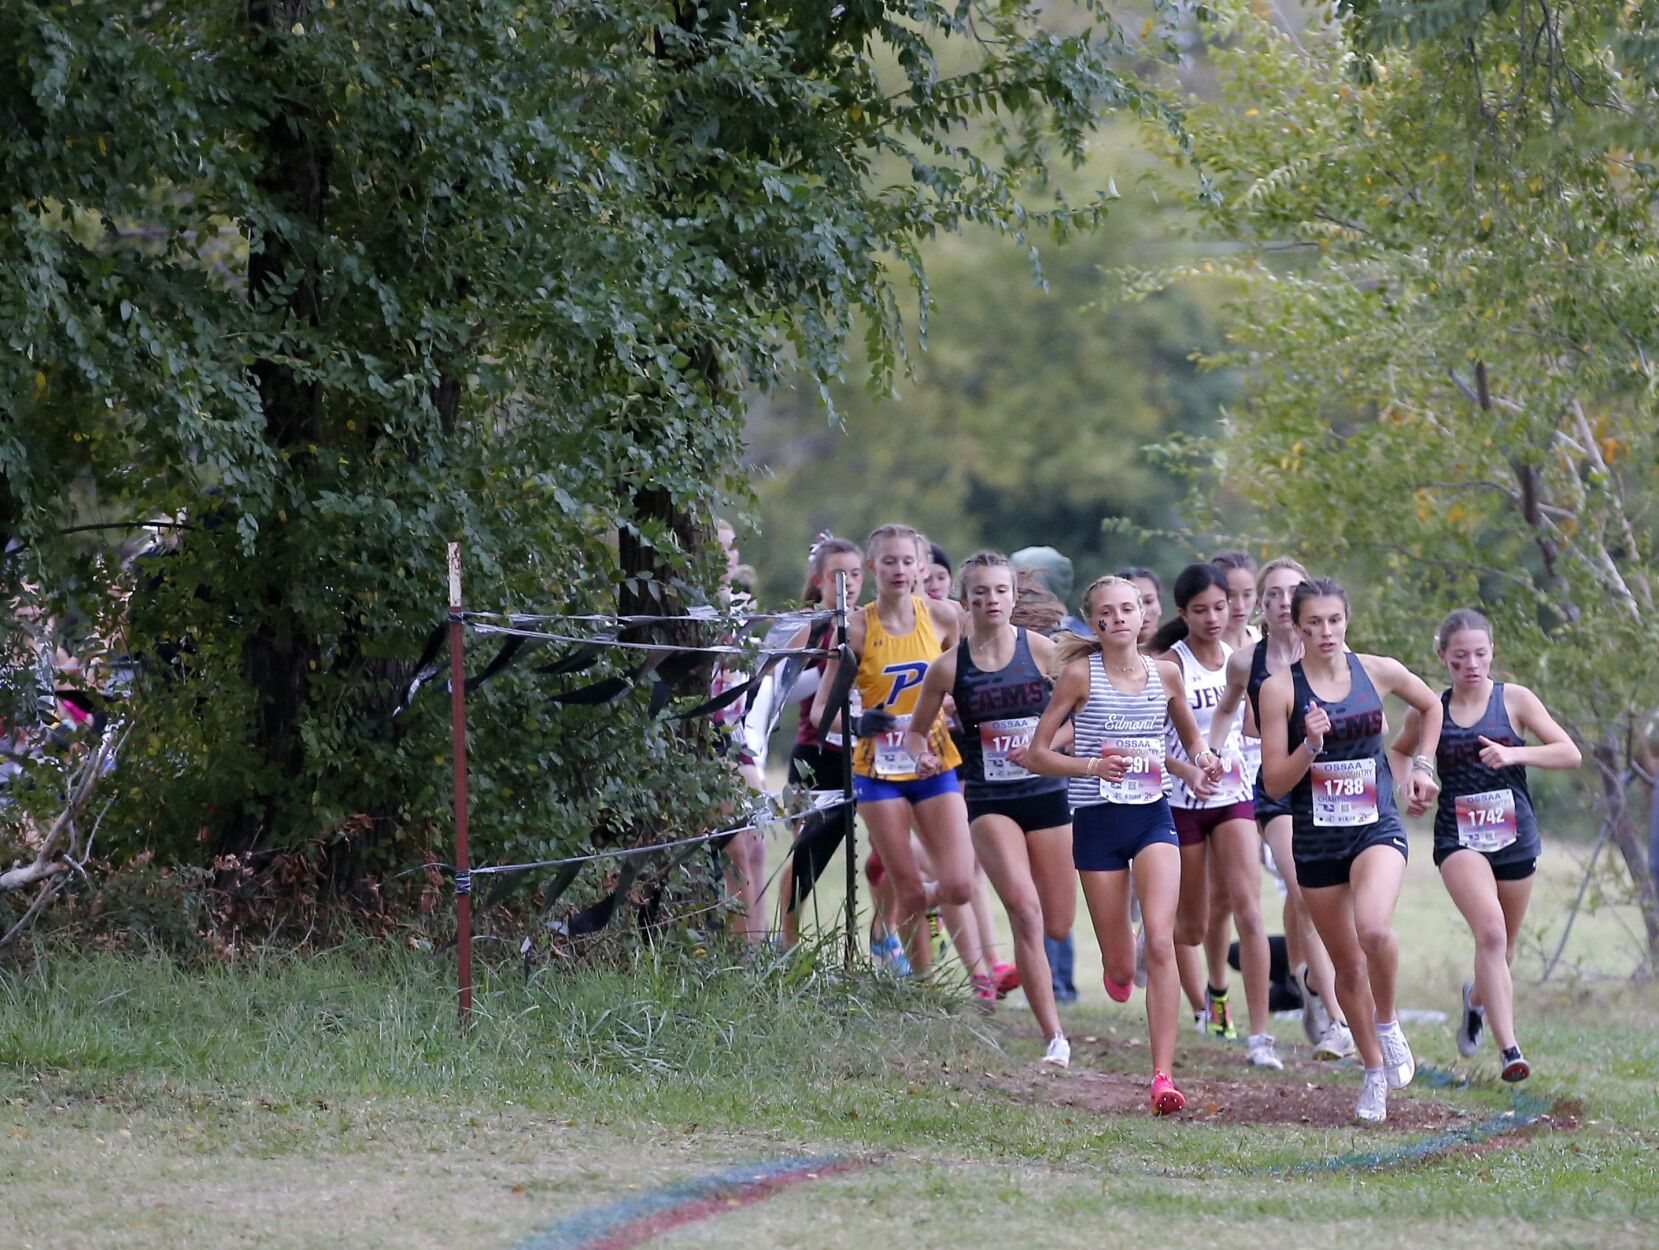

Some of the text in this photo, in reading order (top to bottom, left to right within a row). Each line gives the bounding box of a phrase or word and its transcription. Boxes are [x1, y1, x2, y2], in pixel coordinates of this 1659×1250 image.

[881, 660, 931, 707] P
[992, 720, 1028, 729] OSSAA
[1104, 713, 1157, 731] Edmond
[1115, 740, 1151, 748] OSSAA
[1324, 762, 1362, 771] OSSAA
[1324, 778, 1364, 797] 1738
[1467, 793, 1501, 803] OSSAA
[1468, 808, 1505, 826] 1742
